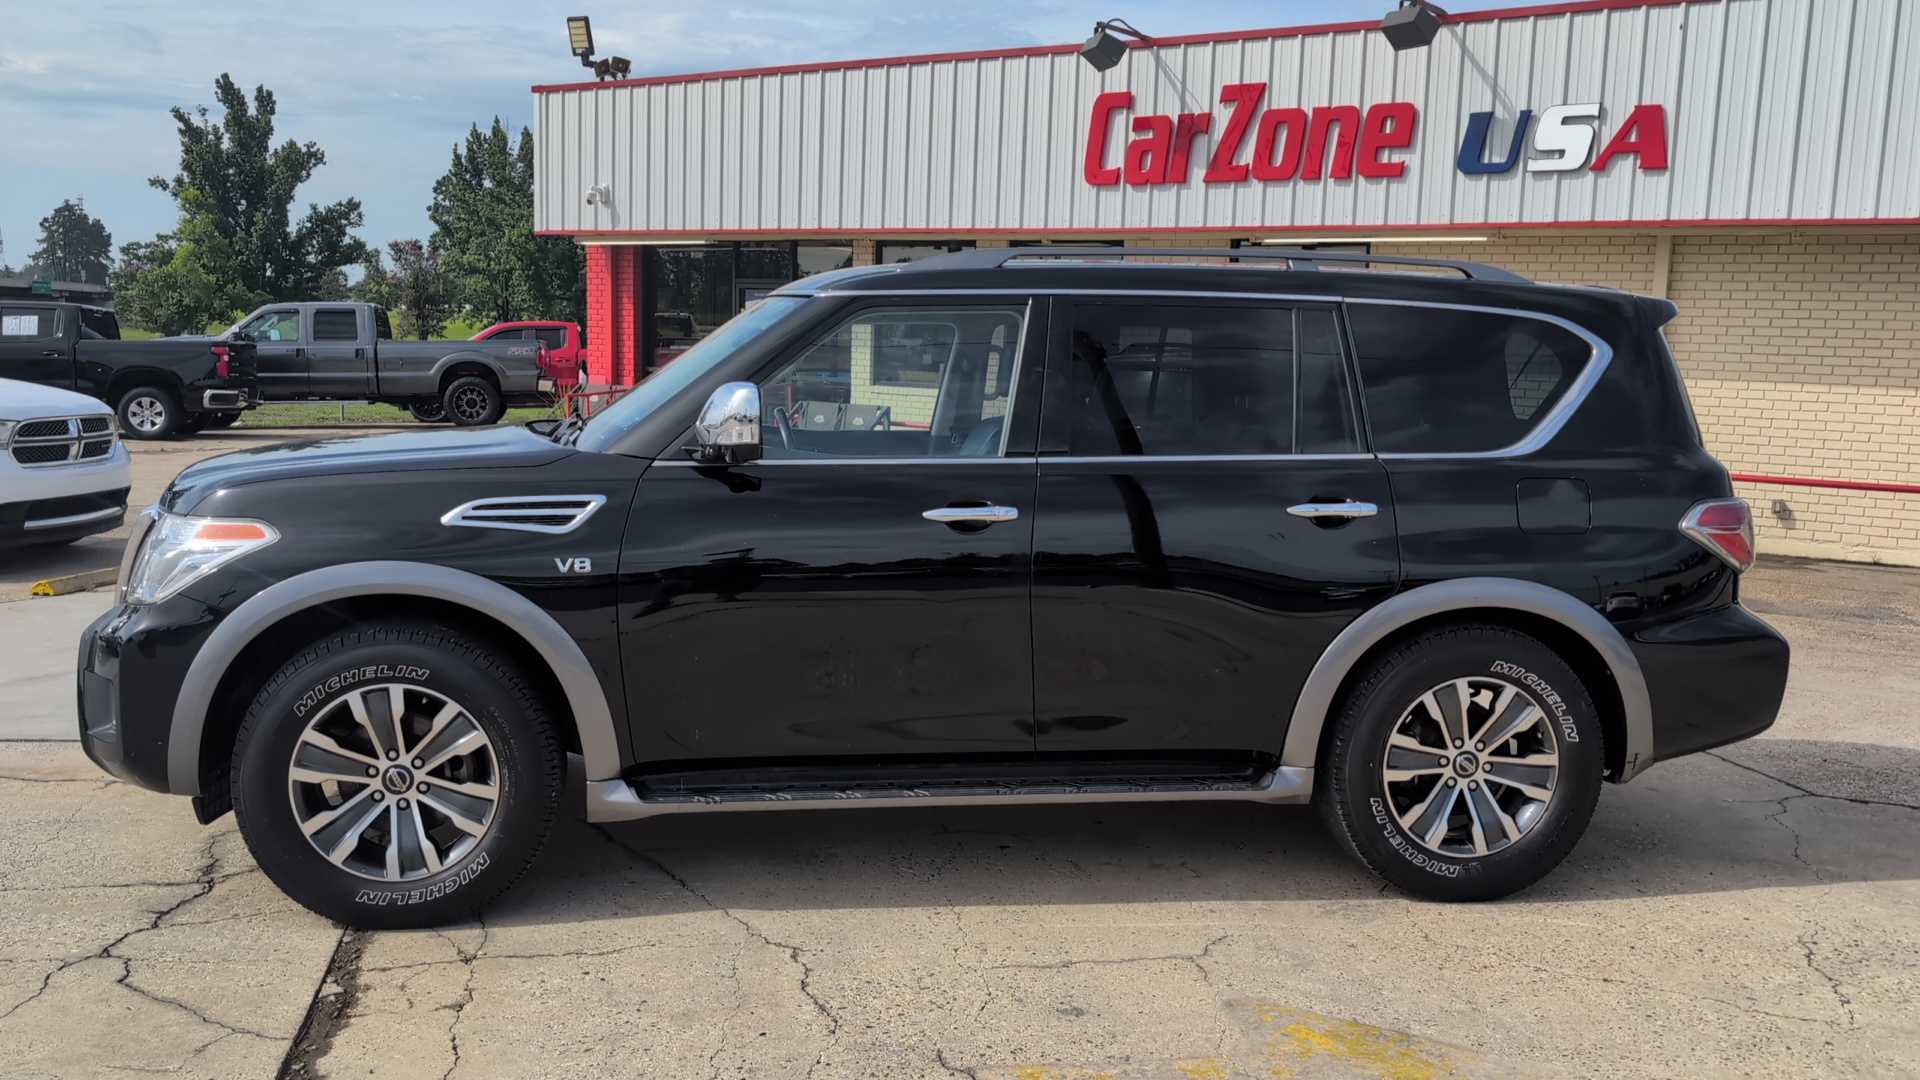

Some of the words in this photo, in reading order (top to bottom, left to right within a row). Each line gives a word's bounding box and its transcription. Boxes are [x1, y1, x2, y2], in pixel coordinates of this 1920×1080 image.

[1084, 82, 1415, 186] CarZone
[1457, 102, 1668, 173] USA
[554, 557, 592, 573] V8
[293, 665, 430, 717] MICHELIN
[1490, 660, 1579, 743] MICHELIN
[1370, 797, 1459, 877] MICHELIN
[355, 851, 490, 905] MICHELIN
